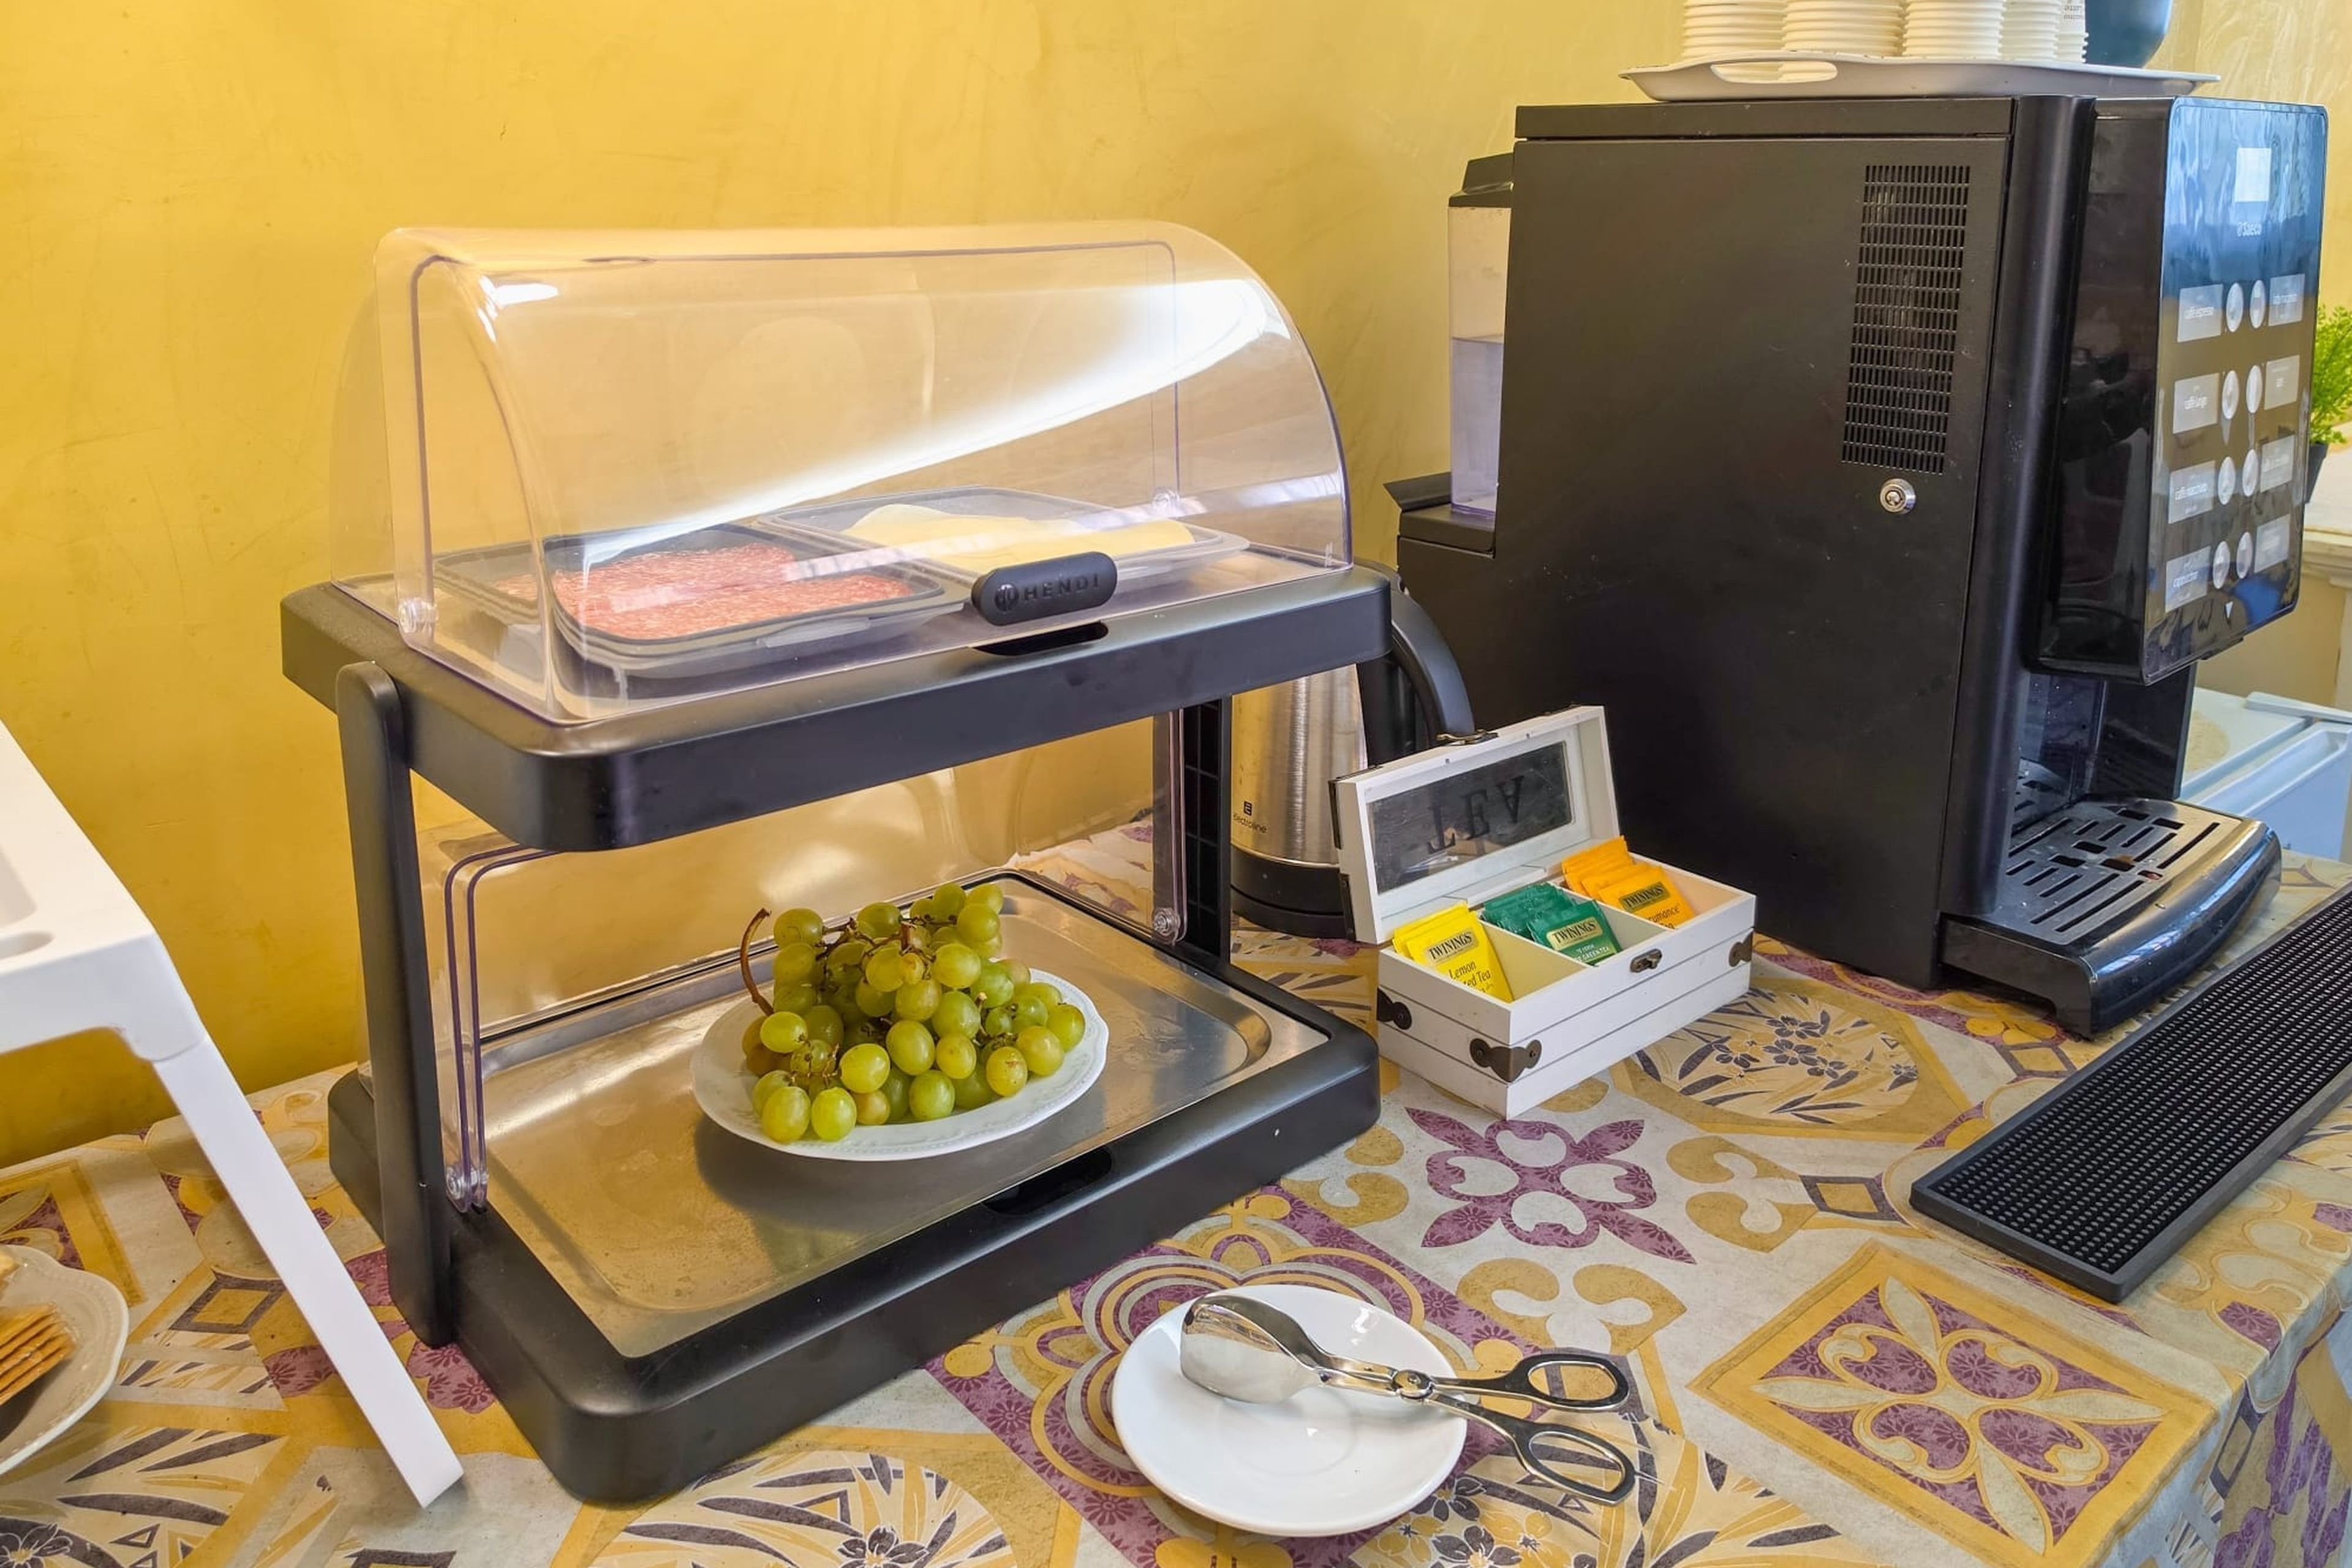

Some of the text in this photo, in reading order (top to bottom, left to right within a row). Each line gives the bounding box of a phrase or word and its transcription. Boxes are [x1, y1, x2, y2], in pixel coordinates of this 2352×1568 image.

[1023, 573, 1100, 601] HENDI
[1623, 885, 1665, 908] TWININGS
[1552, 921, 1596, 944] TWININGS
[1428, 931, 1472, 960] TWININGS
[1448, 961, 1477, 980] Lemon
[1476, 970, 1491, 983] Tea
